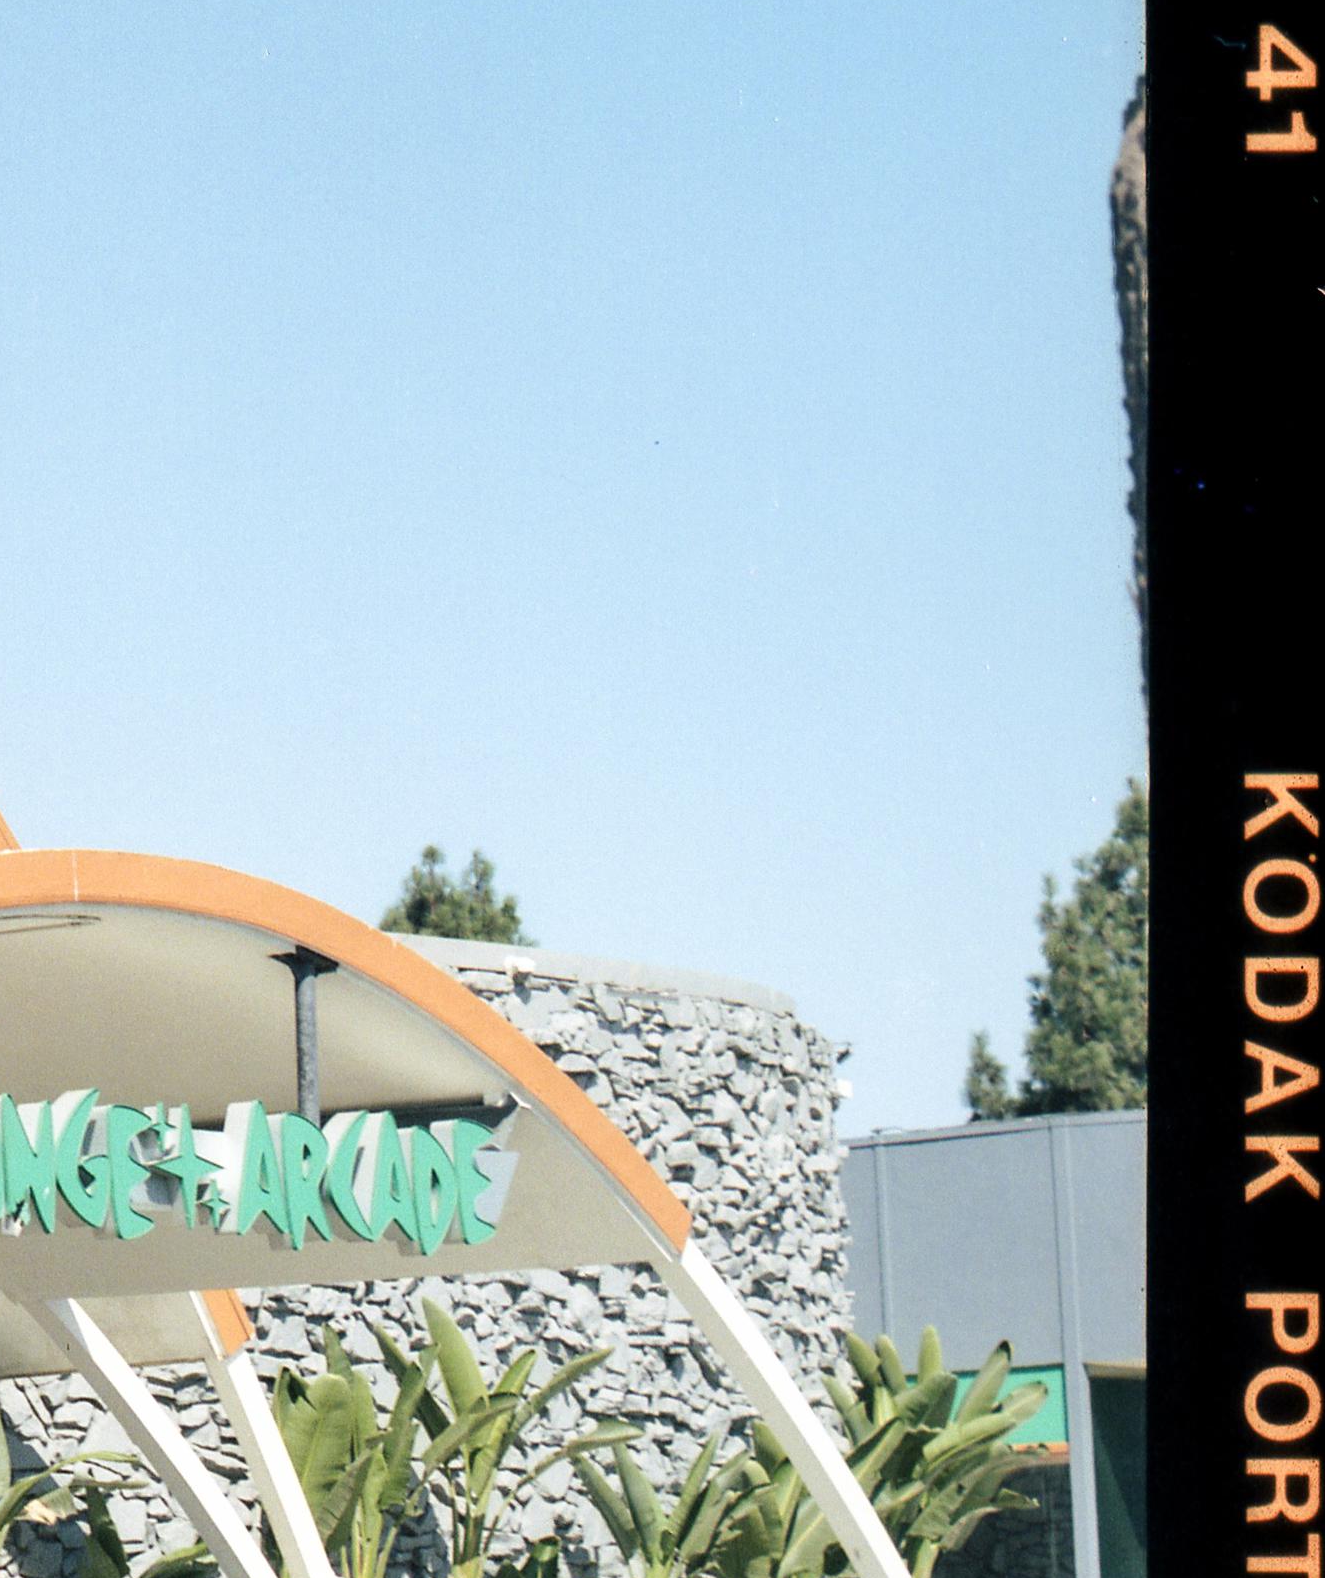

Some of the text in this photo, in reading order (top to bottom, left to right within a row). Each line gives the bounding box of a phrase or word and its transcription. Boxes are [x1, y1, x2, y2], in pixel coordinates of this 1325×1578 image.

[1246, 24, 1317, 152] 41
[1243, 773, 1320, 1202] KODAK
[228, 1100, 497, 1256] ARCADE
